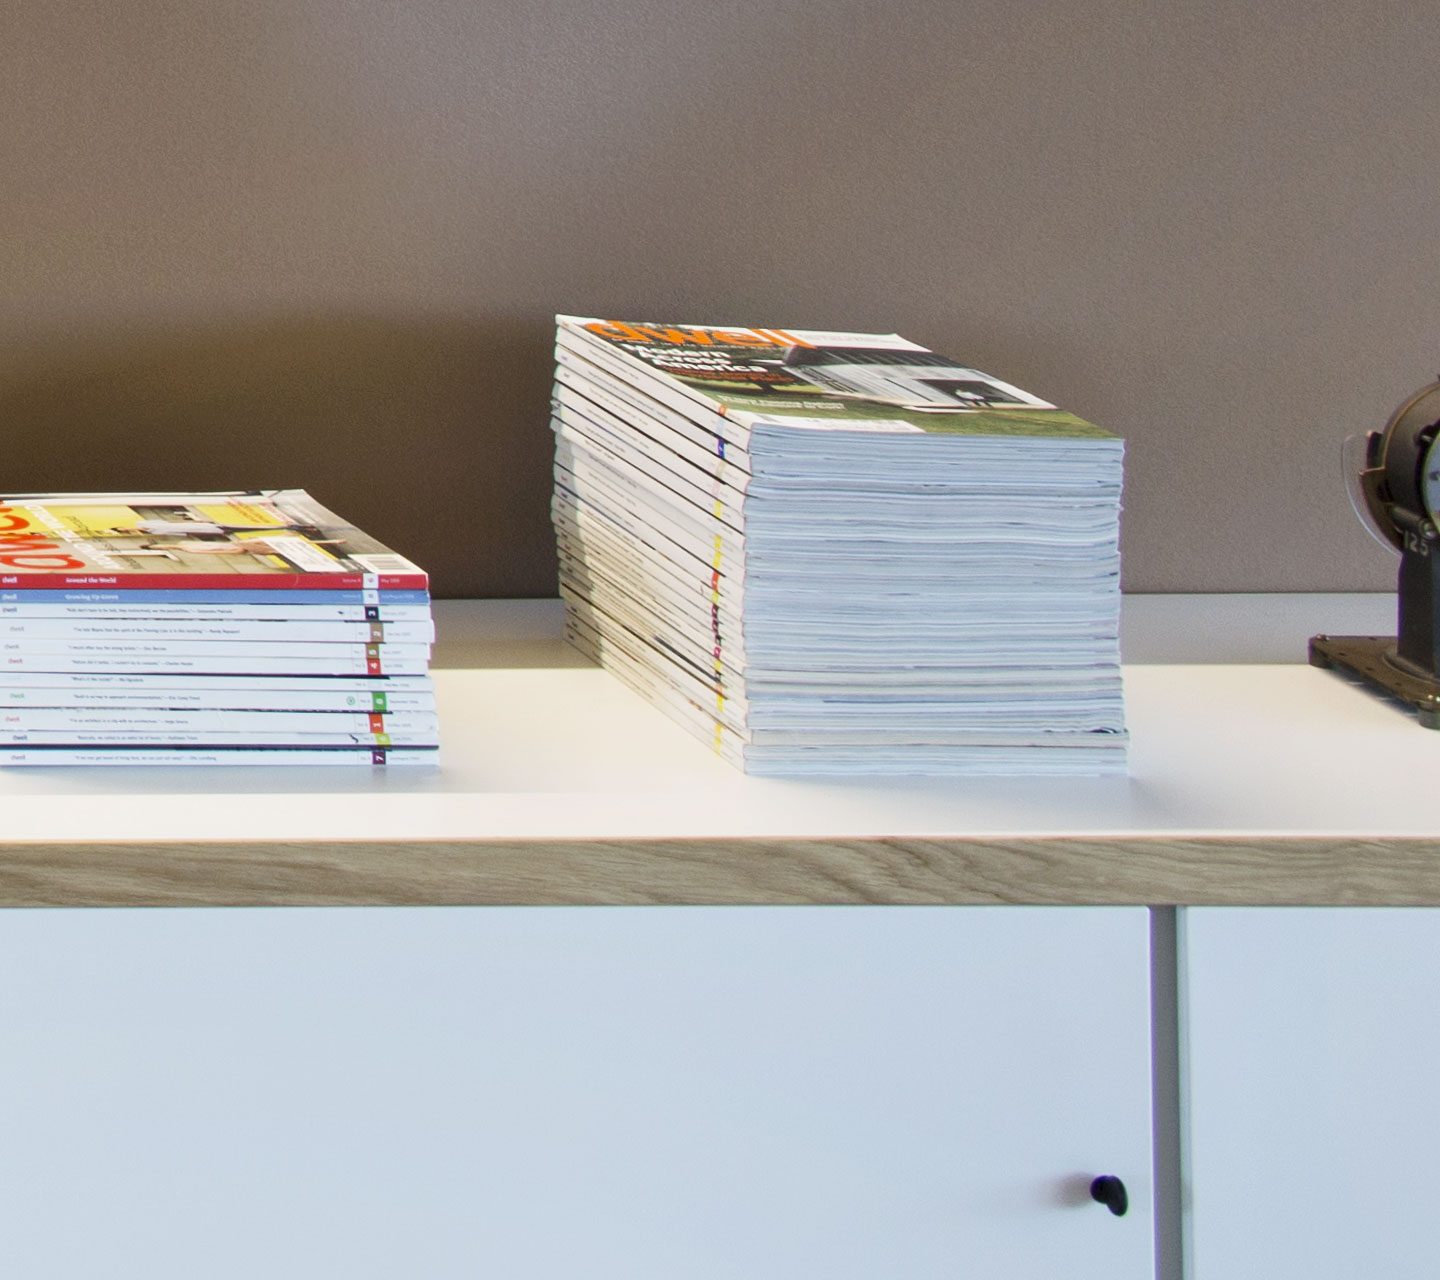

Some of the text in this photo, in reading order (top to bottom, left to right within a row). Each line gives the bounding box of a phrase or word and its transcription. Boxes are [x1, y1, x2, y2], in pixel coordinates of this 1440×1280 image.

[585, 320, 816, 349] dwell
[621, 343, 732, 359] Modern
[638, 350, 732, 365] Across
[652, 358, 768, 373] America
[65, 594, 90, 602] Growing
